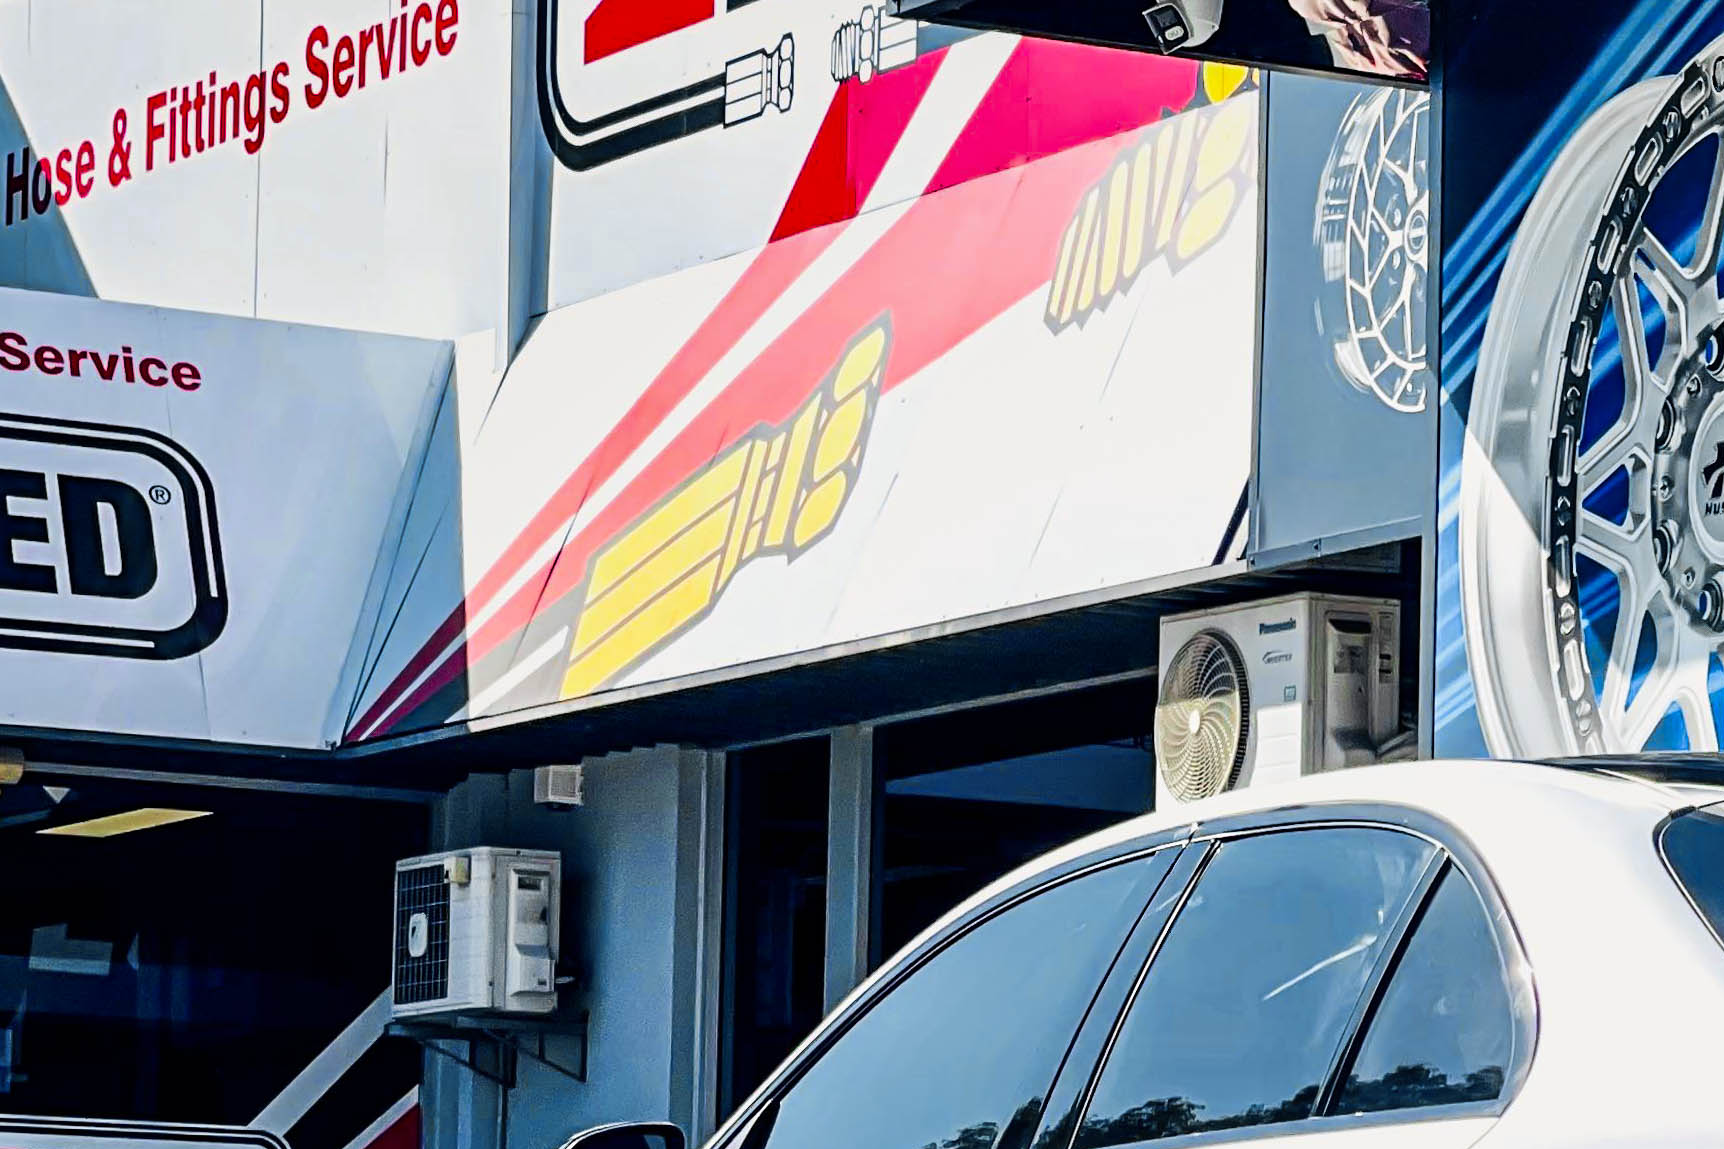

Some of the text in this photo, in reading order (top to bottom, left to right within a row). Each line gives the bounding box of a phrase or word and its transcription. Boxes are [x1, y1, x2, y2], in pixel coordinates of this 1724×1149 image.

[5, 0, 459, 226] Hose & Fittings Service
[0, 331, 202, 391] Service
